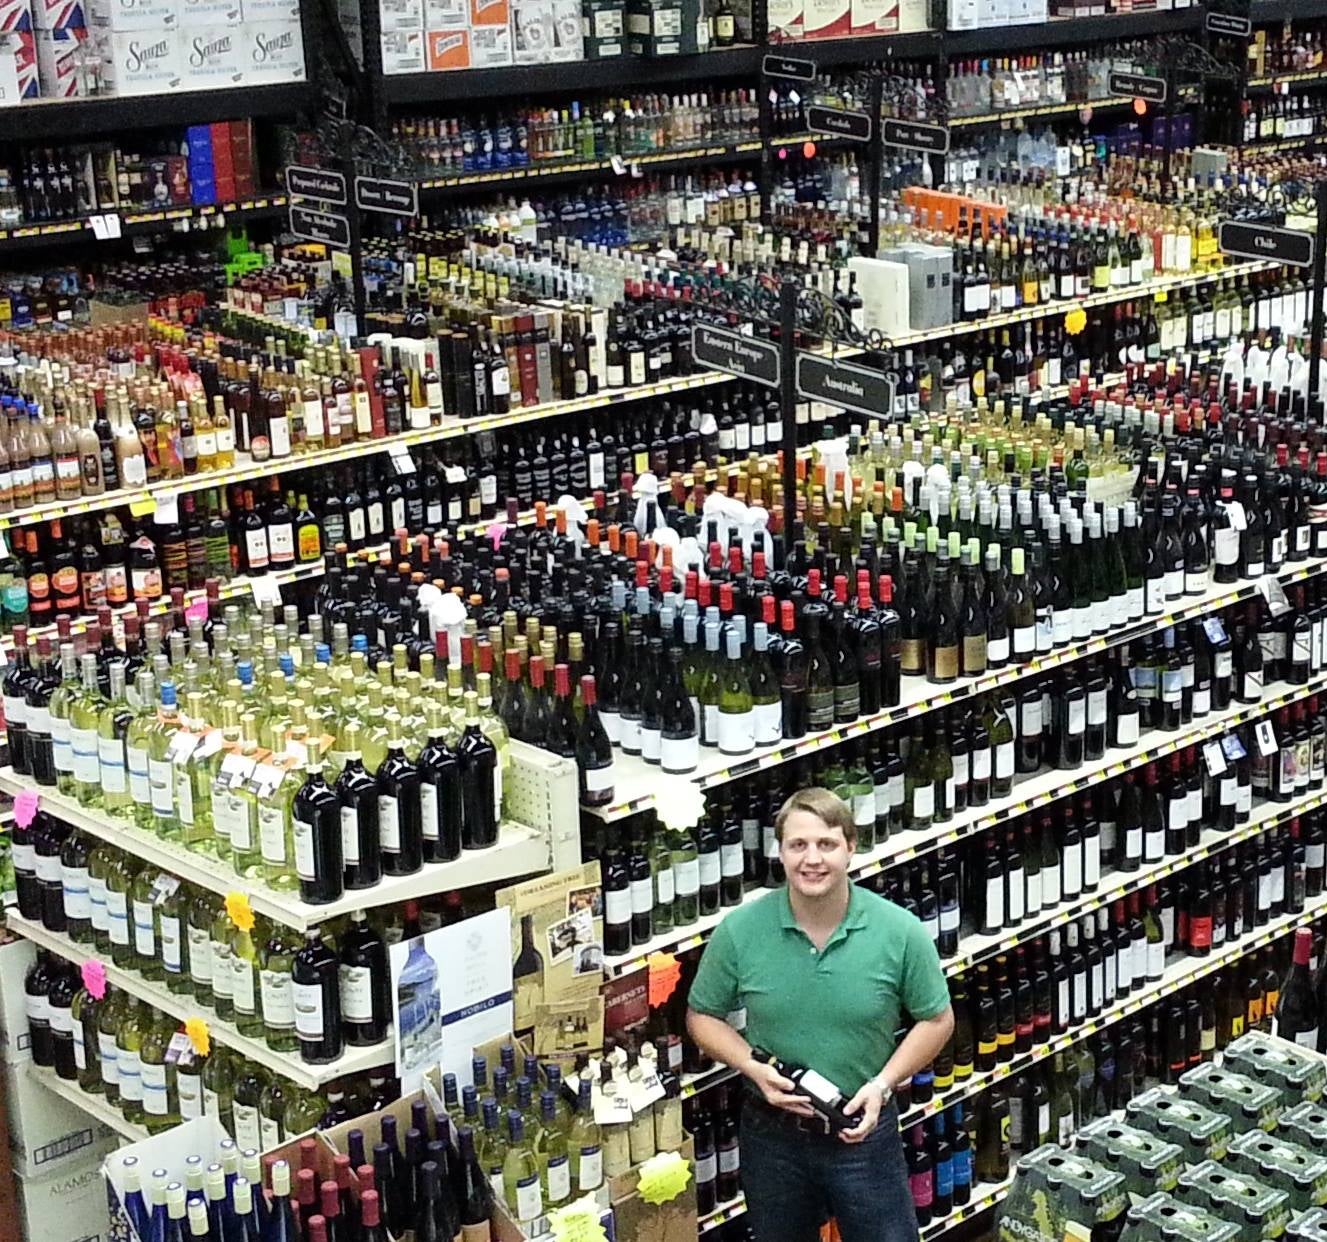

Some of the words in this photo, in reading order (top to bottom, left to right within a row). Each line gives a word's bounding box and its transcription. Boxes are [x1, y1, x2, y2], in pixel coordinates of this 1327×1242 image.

[126, 40, 168, 72] Sauza
[189, 36, 232, 68] Sauza
[253, 32, 293, 63] Sauza
[1254, 236, 1277, 249] Chile
[703, 332, 733, 351] Eastern
[734, 344, 763, 363] Europe
[822, 374, 864, 397] Australia
[460, 998, 495, 1018] NOBILO
[49, 1169, 100, 1196] ALAMOS
